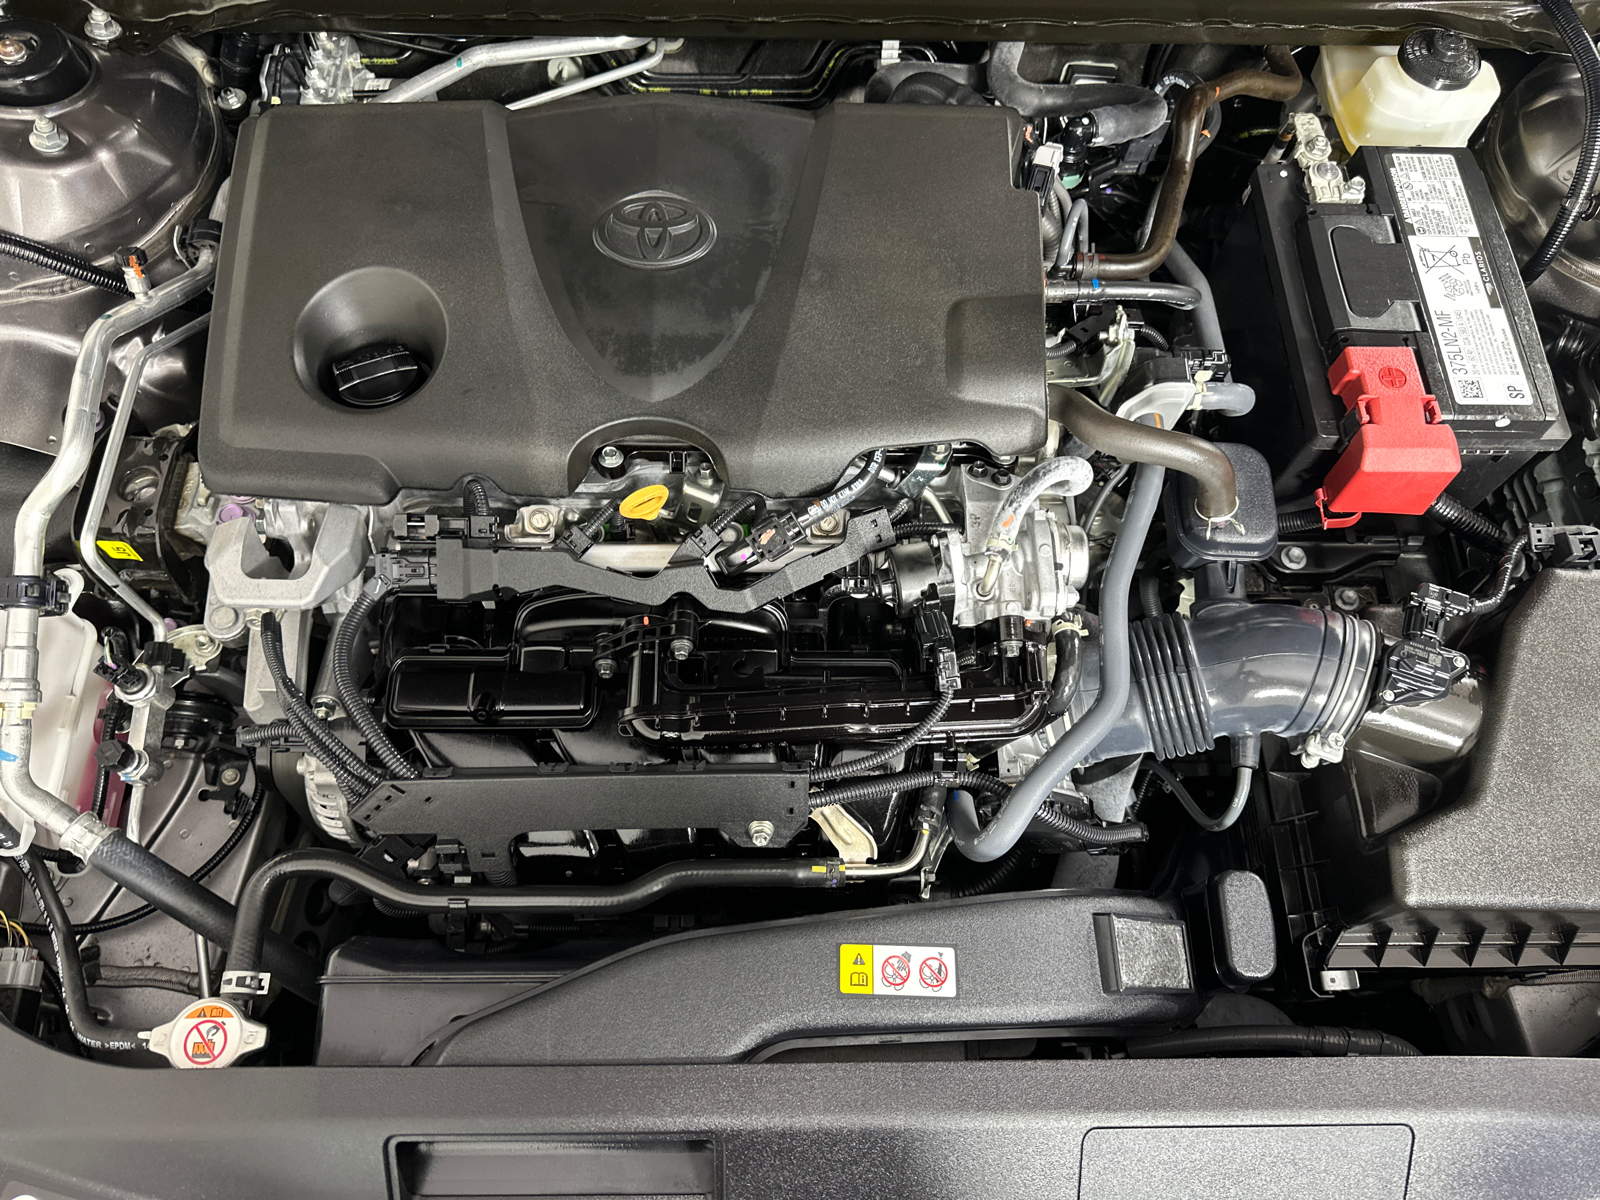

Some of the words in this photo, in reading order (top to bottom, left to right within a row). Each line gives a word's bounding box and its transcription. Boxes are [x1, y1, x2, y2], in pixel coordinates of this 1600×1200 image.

[1462, 253, 1472, 264] Pb
[1474, 251, 1490, 281] CLARIOS
[1434, 310, 1467, 374] 375LN2-MF
[1507, 385, 1525, 399] SP
[75, 1032, 102, 1049] WATER
